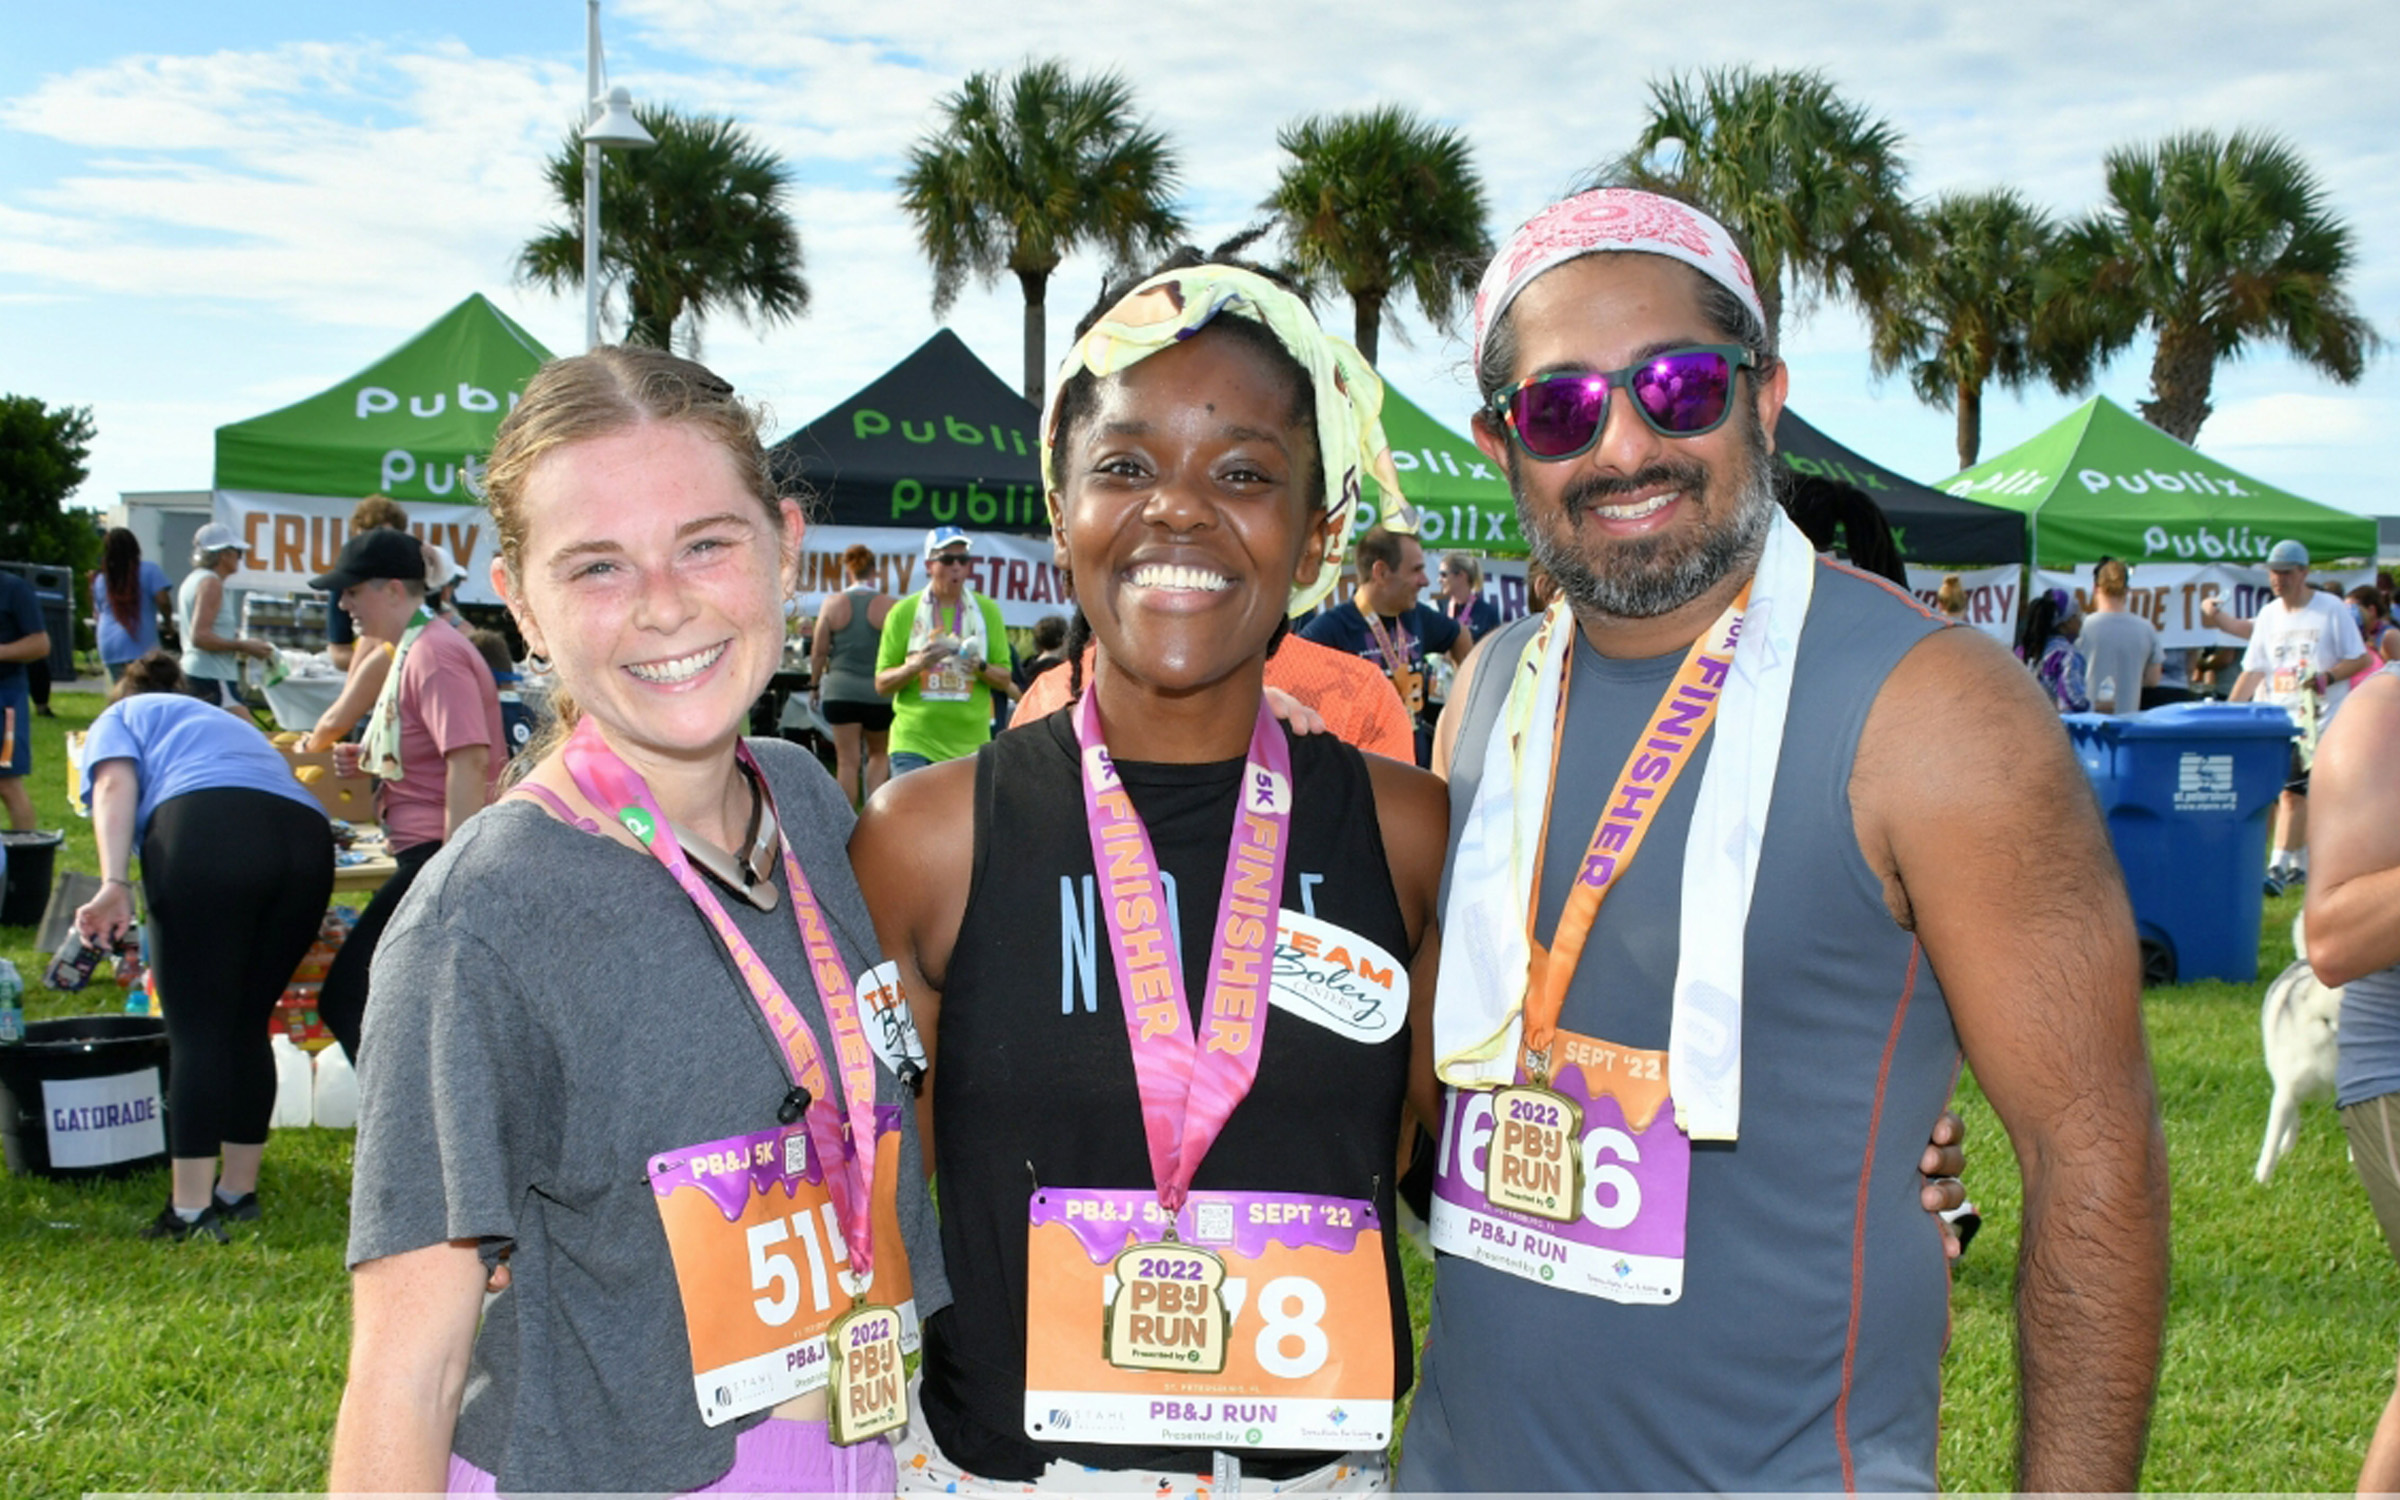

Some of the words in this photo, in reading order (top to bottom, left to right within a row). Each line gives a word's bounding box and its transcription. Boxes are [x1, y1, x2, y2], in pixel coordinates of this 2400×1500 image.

[355, 382, 519, 419] Publ
[852, 409, 1042, 455] Publi
[381, 449, 488, 499] Pub
[1391, 448, 1497, 481] blix
[1784, 451, 1889, 491] blix
[2078, 468, 2249, 498] Publix
[891, 479, 1053, 525] Publi
[1349, 500, 1506, 542] Pblix
[1255, 771, 1275, 808] 5K
[1576, 655, 1733, 888] FINISHER
[1095, 790, 1181, 1044] FINISHER
[1206, 812, 1280, 1057] FINISHER
[1276, 926, 1394, 991] EAM
[863, 979, 906, 1014] TEA
[1564, 1040, 1617, 1073] SEPT
[53, 1096, 156, 1132] GATORADE
[1509, 1098, 1559, 1127] 2022
[1503, 1119, 1563, 1162] PB&J
[689, 1147, 751, 1180] PB&J
[754, 1141, 775, 1167] 5K
[1501, 1153, 1561, 1196] RUN
[1066, 1200, 1134, 1222] PB&J
[1249, 1203, 1312, 1225] SEPT
[1468, 1216, 1517, 1247] PB&J
[1523, 1234, 1568, 1263] RUN
[1139, 1258, 1204, 1281] 2022
[1130, 1280, 1209, 1316] PB&J
[850, 1318, 890, 1347] 2022
[1129, 1314, 1208, 1349] RUN
[786, 1341, 826, 1372] PB&J
[848, 1339, 895, 1384] PB&J
[849, 1374, 898, 1418] RUN
[1150, 1402, 1213, 1422] PB&J
[1223, 1403, 1278, 1423] RUN
[1161, 1428, 1223, 1442] Presented
